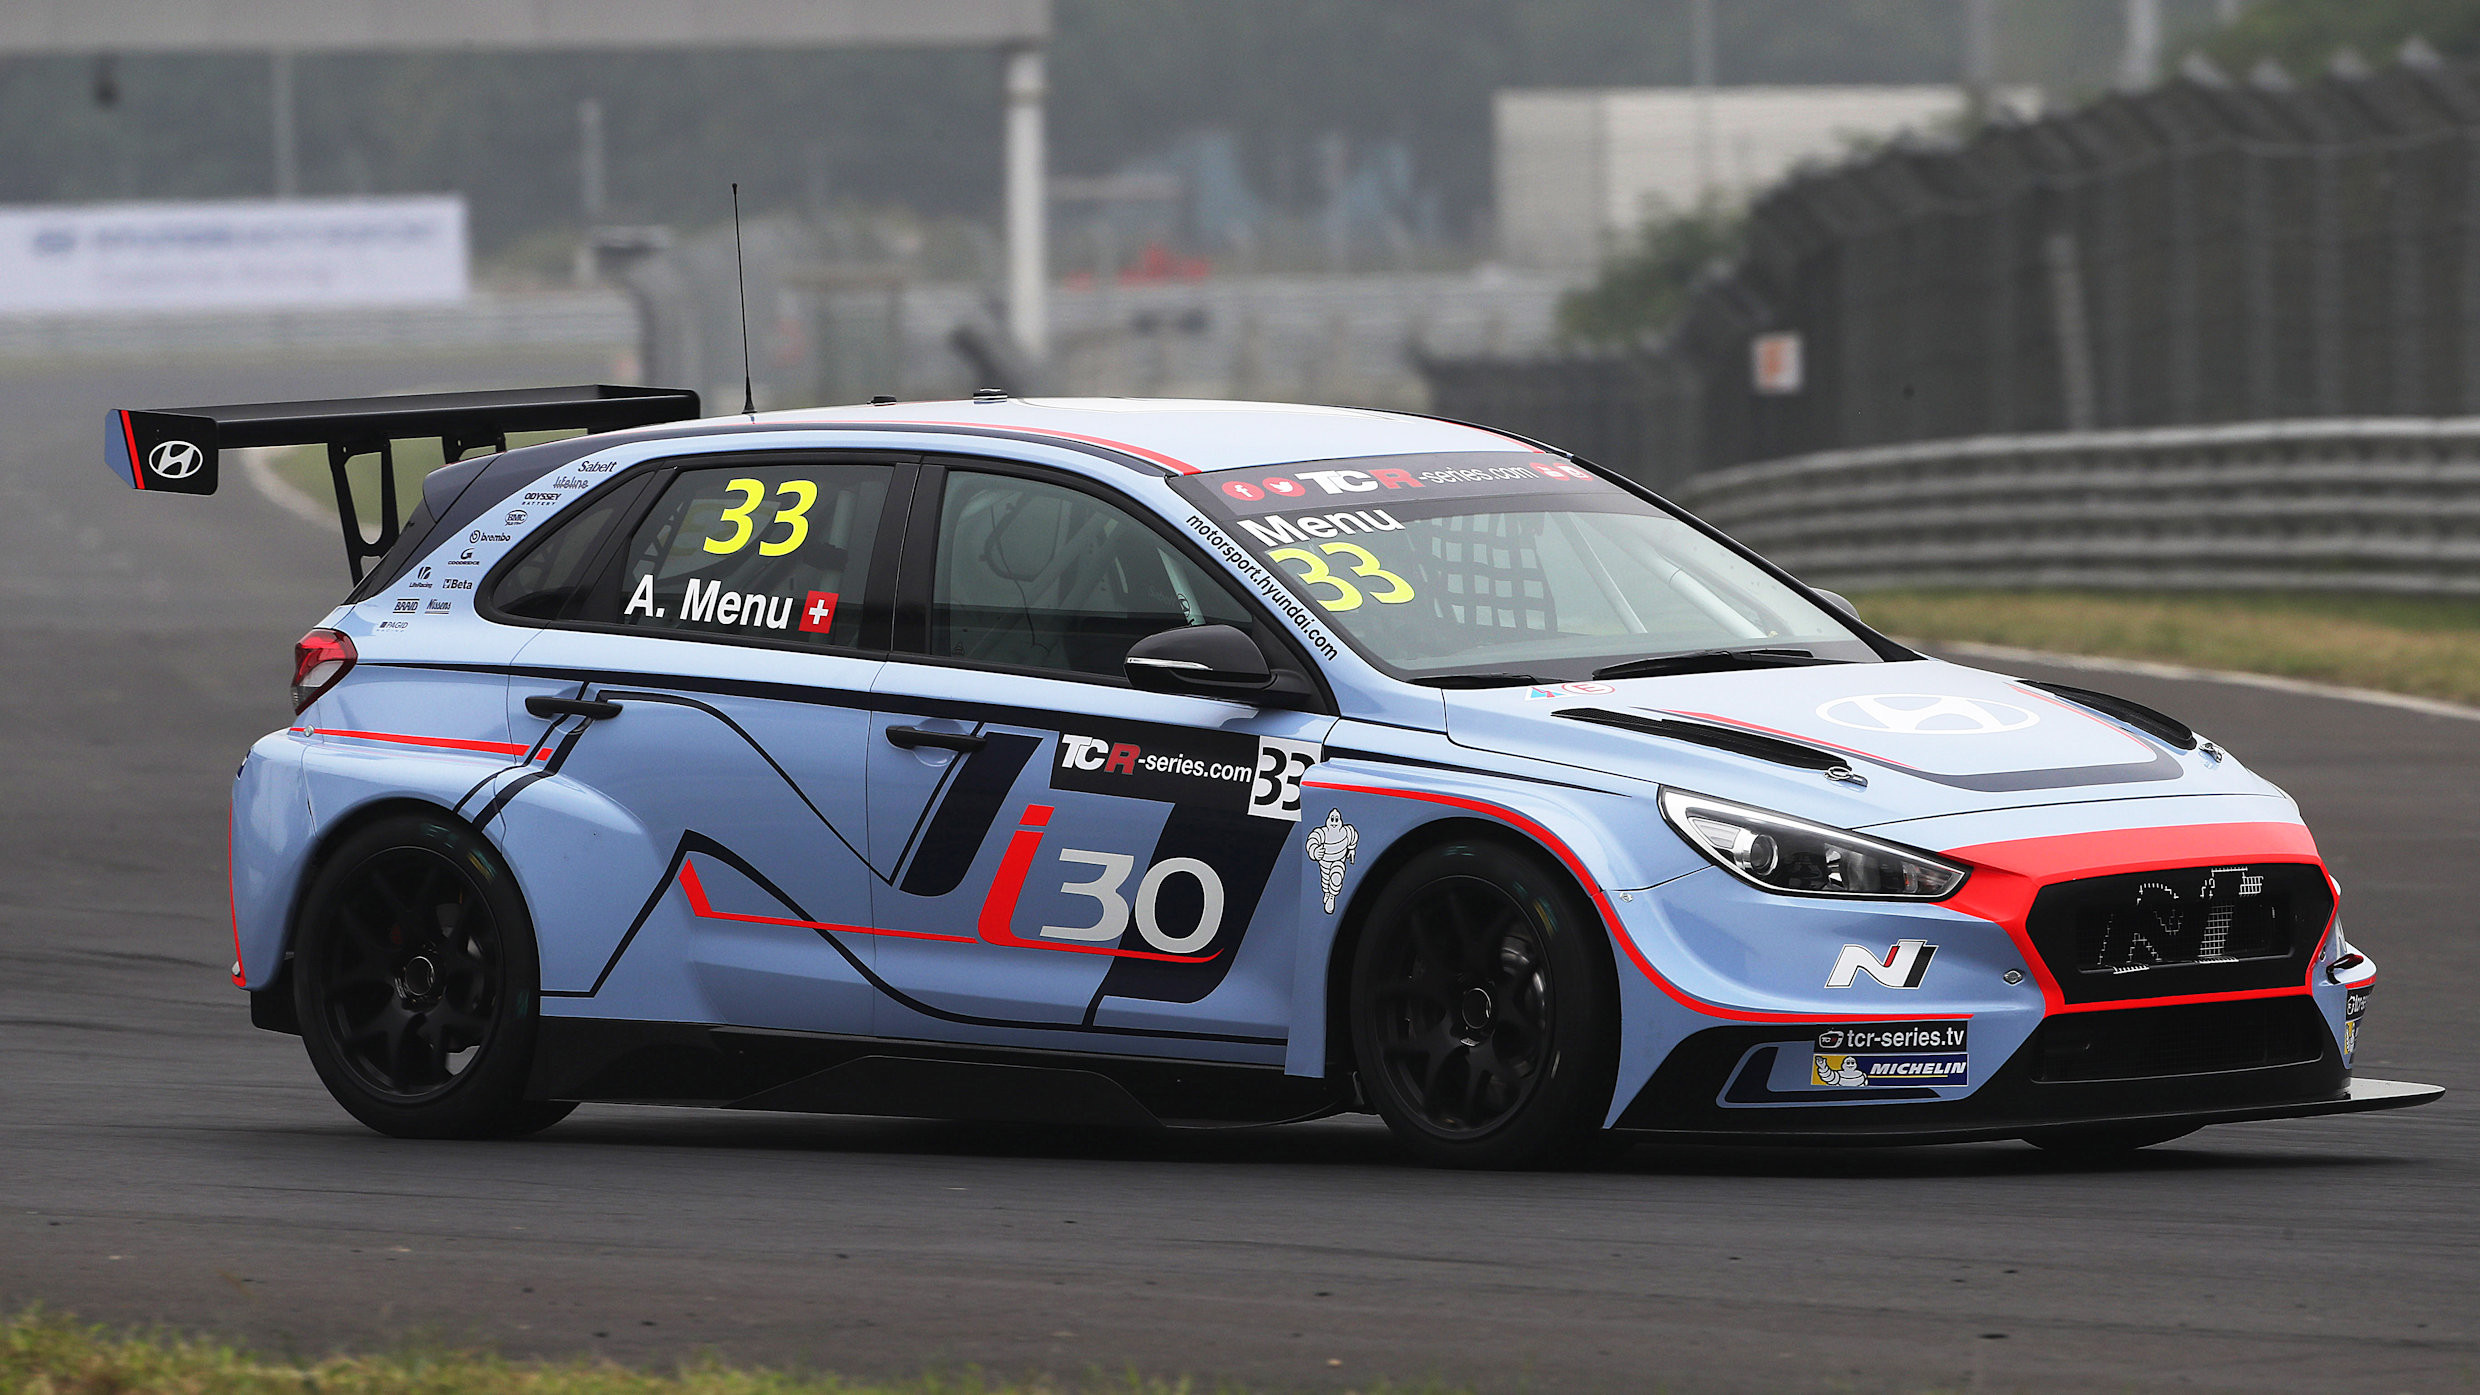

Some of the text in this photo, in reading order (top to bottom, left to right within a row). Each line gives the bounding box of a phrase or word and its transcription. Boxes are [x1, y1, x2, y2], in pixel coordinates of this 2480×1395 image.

[578, 460, 617, 473] Sabelt
[1294, 466, 1540, 495] TCR-series.com
[524, 492, 562, 501] ODYSSEY
[507, 513, 526, 522] BMC
[702, 478, 819, 557] 33
[1236, 509, 1406, 547] Menu
[480, 532, 511, 542] brembo
[450, 579, 473, 590] Beta
[1268, 541, 1415, 612] 33
[1186, 514, 1338, 661] motorsport.hyundai.com
[393, 601, 419, 611] BRAID
[426, 599, 452, 610] Nissens
[624, 574, 794, 630] A. Menu
[386, 621, 409, 629] PAGID
[1060, 733, 1316, 812] TCR-series.com 33
[977, 804, 1225, 964] i30
[1847, 1027, 1965, 1048] tcr-series.tv
[1869, 1062, 1967, 1075] MICHELIN
